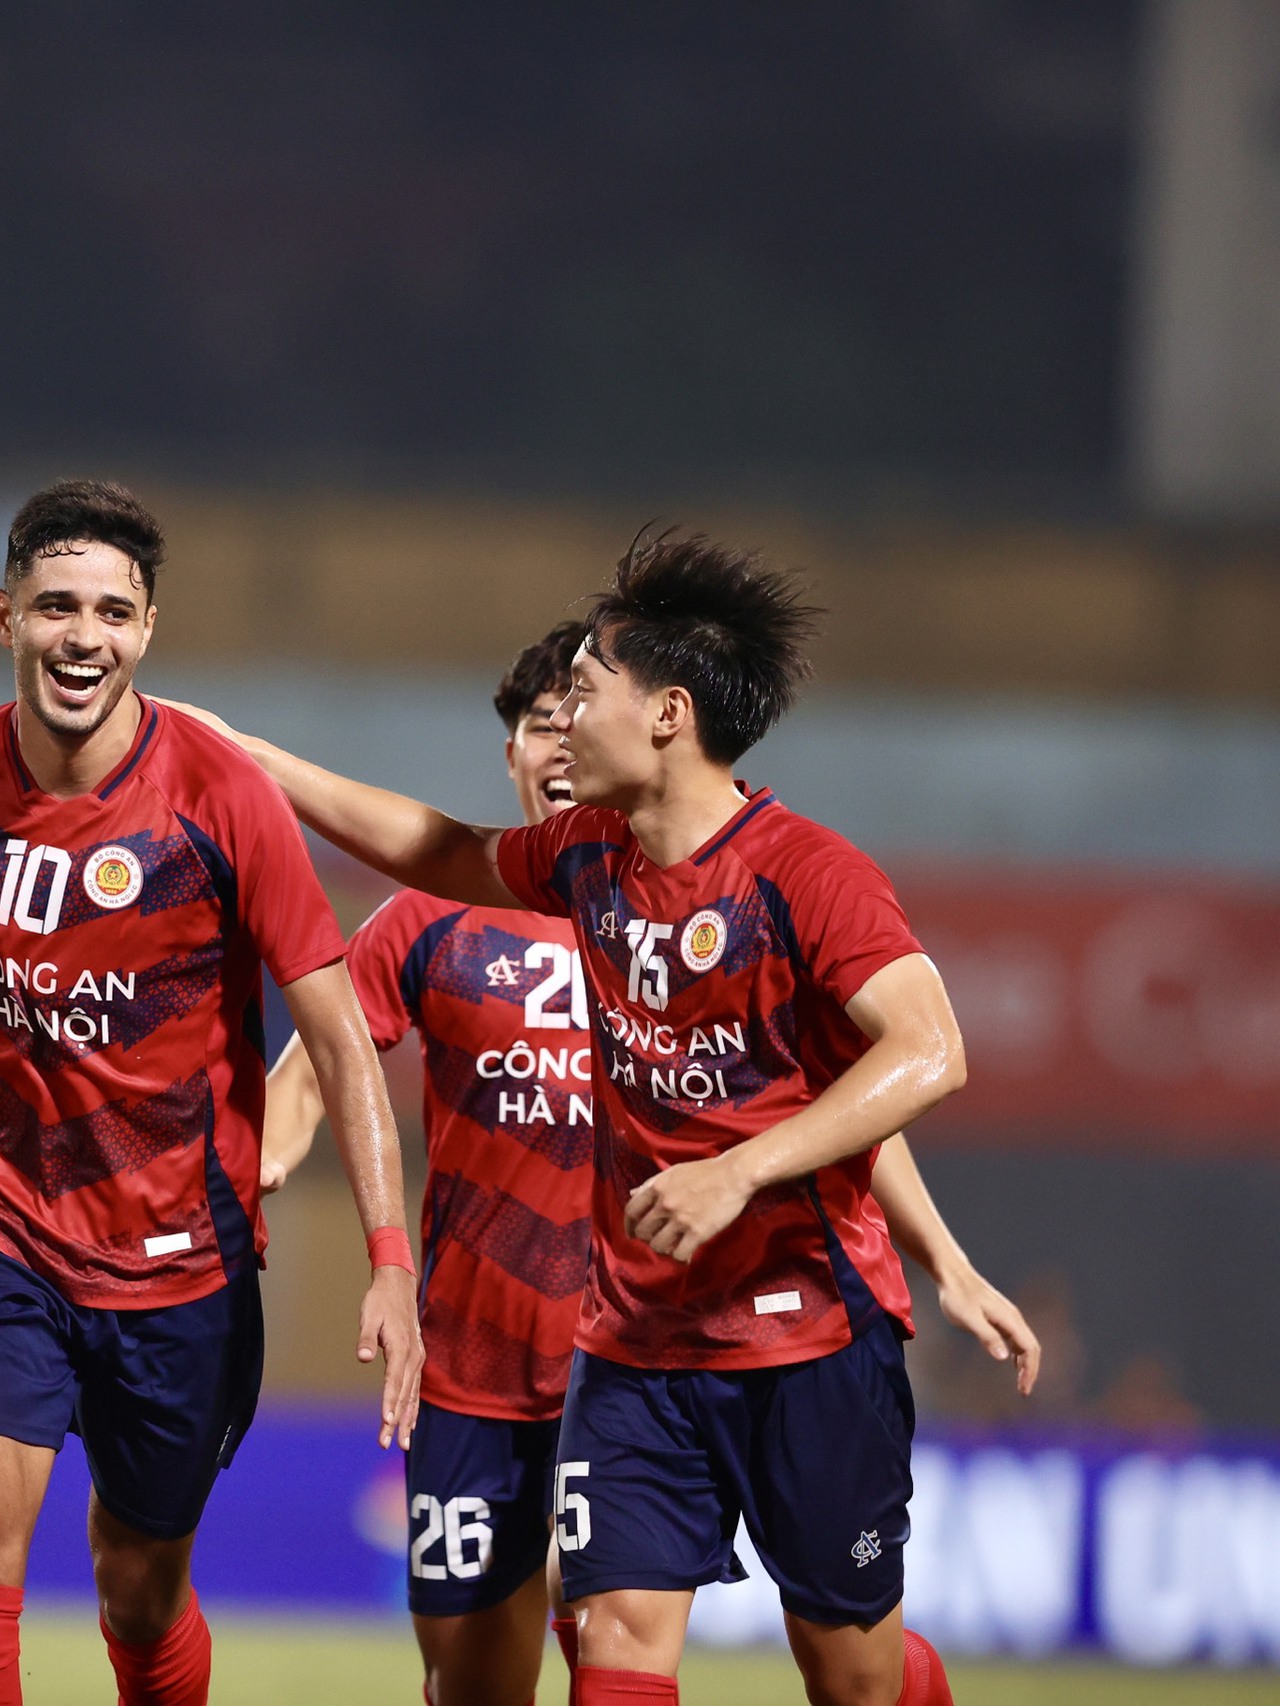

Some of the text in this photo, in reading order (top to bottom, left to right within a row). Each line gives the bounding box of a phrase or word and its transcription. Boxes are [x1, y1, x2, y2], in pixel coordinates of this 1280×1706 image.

[68, 969, 136, 1001] AN
[624, 919, 674, 1012] 15
[34, 1007, 110, 1050] NỘI
[688, 1022, 746, 1057] AN
[498, 1085, 556, 1125] HÀ
[651, 1063, 728, 1107] NỘI
[411, 1493, 493, 1580] 26
